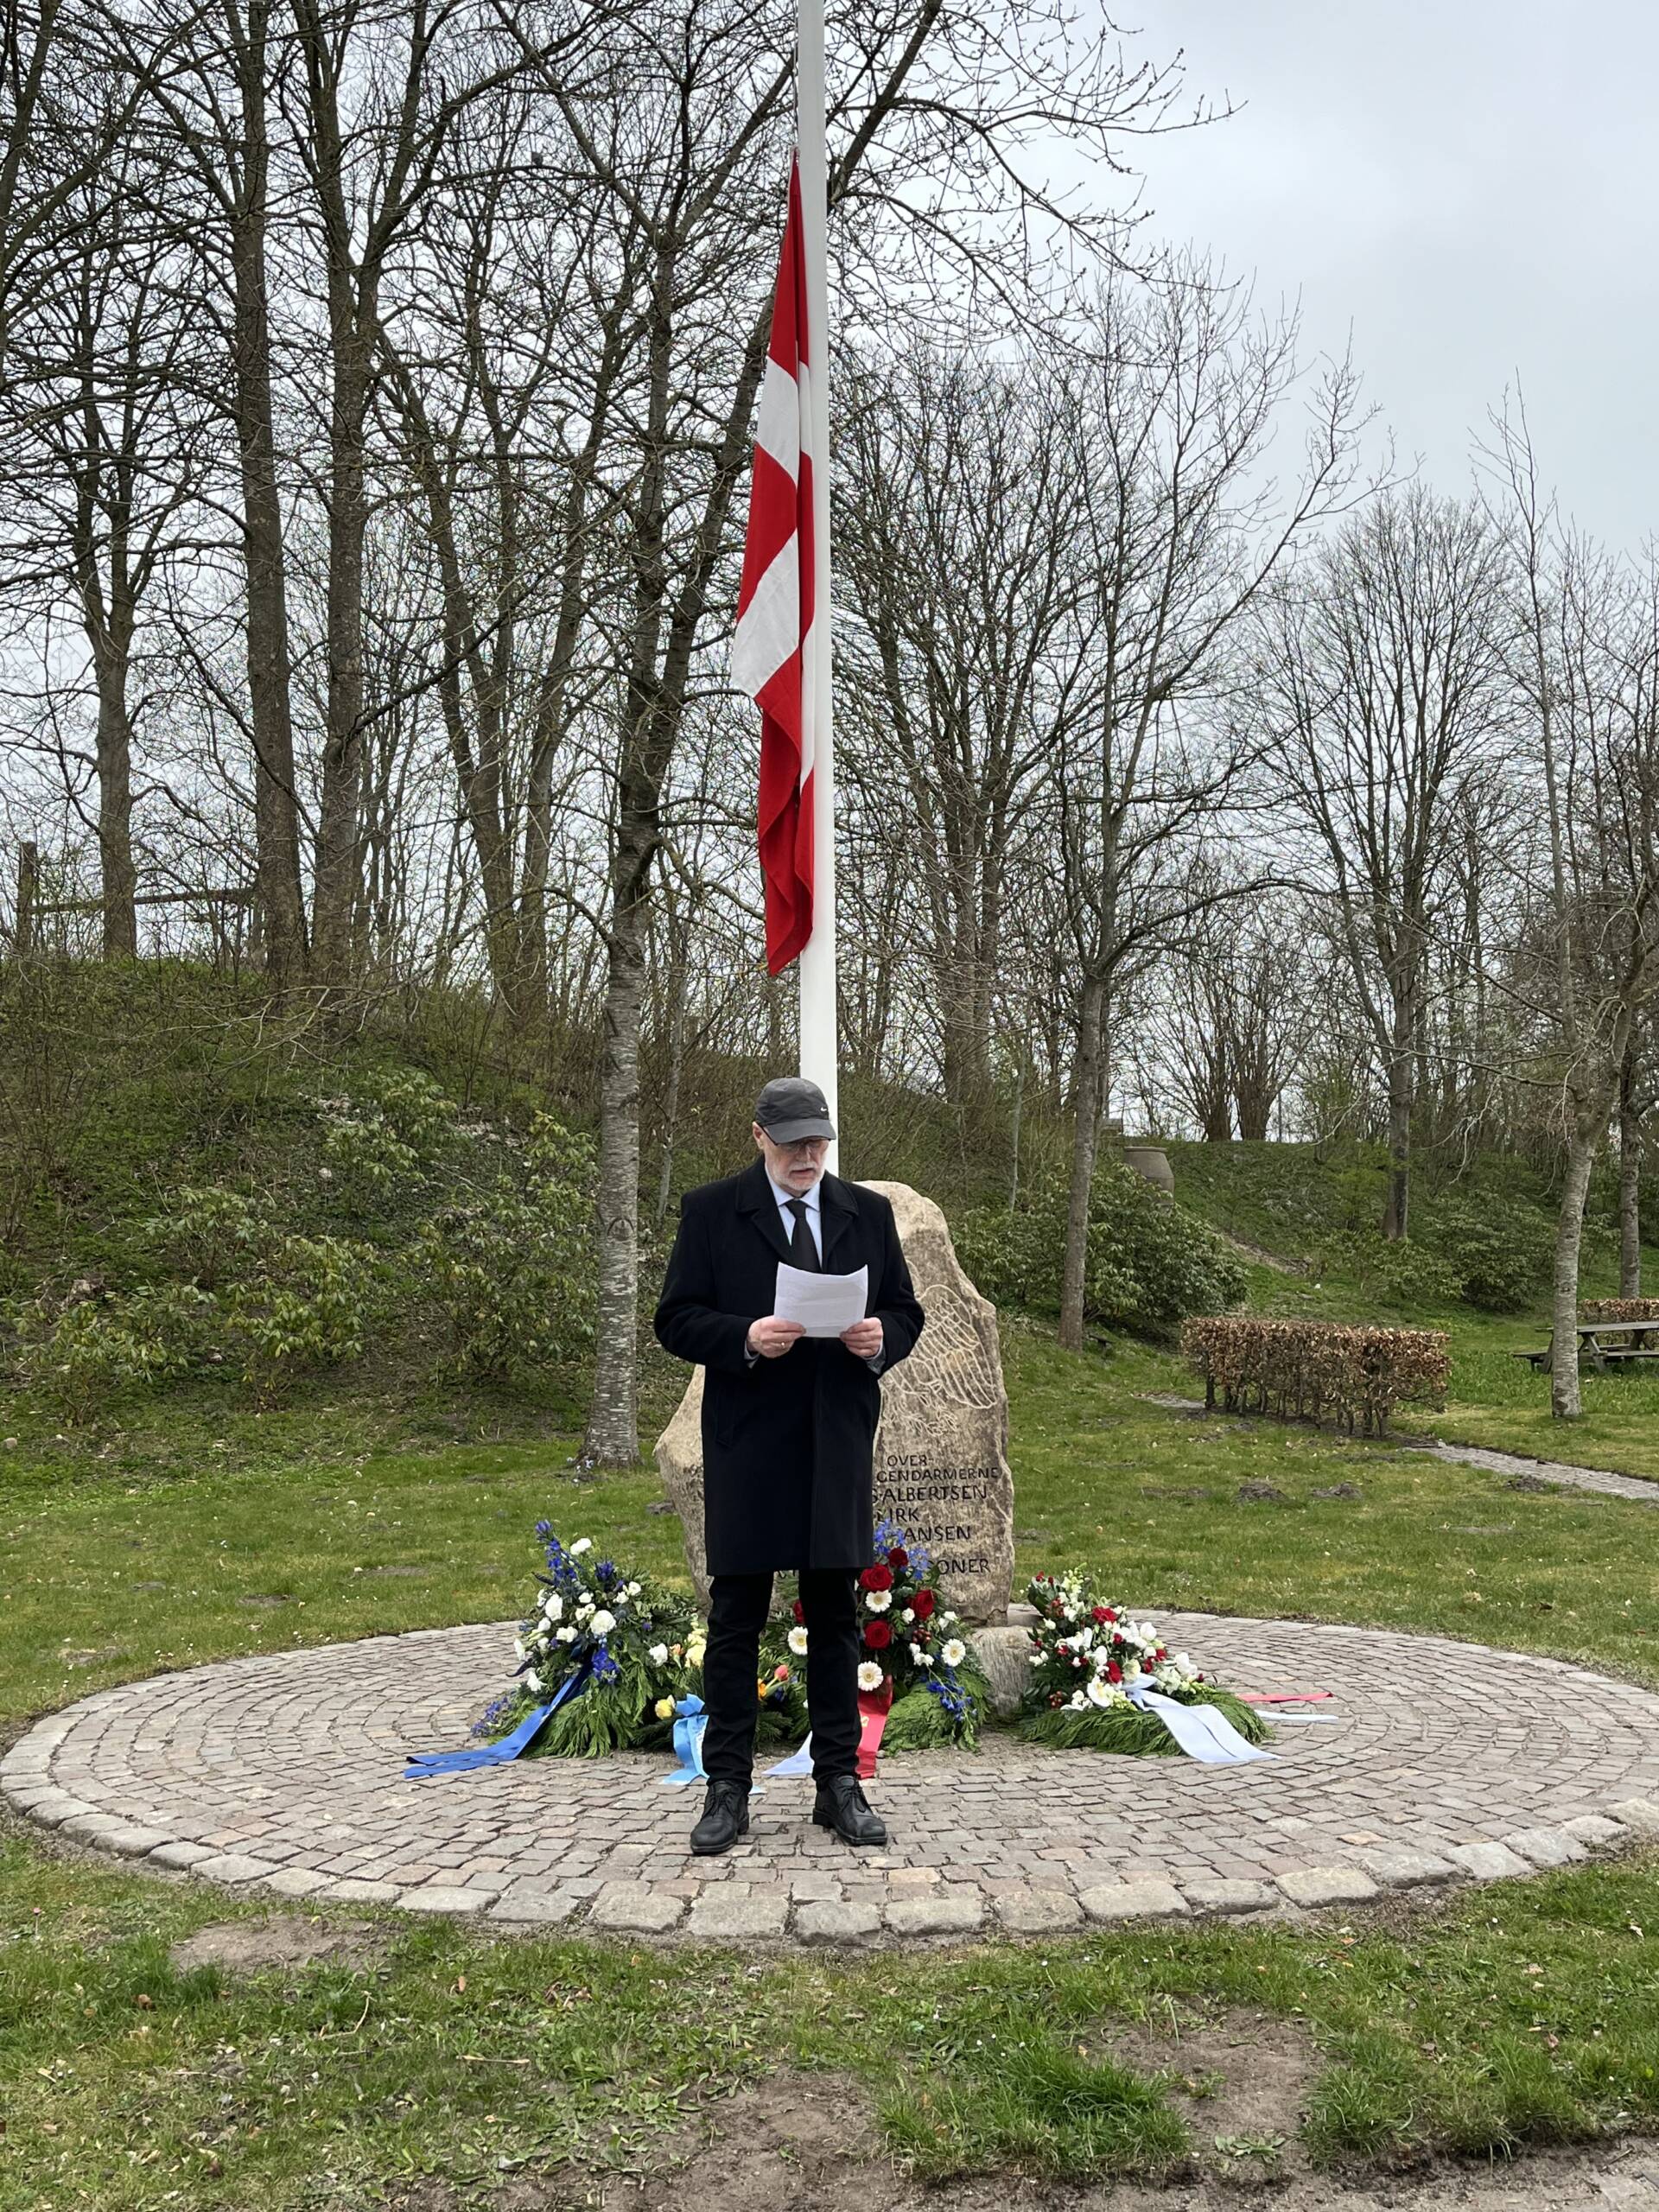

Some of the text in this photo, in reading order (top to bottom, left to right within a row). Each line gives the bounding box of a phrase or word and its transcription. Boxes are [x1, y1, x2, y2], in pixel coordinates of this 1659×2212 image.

[887, 1454, 934, 1467] OVER-
[876, 1467, 999, 1483] GENDARMERNE
[891, 1526, 970, 1542] ANSEN
[927, 1558, 991, 1575] ONER
